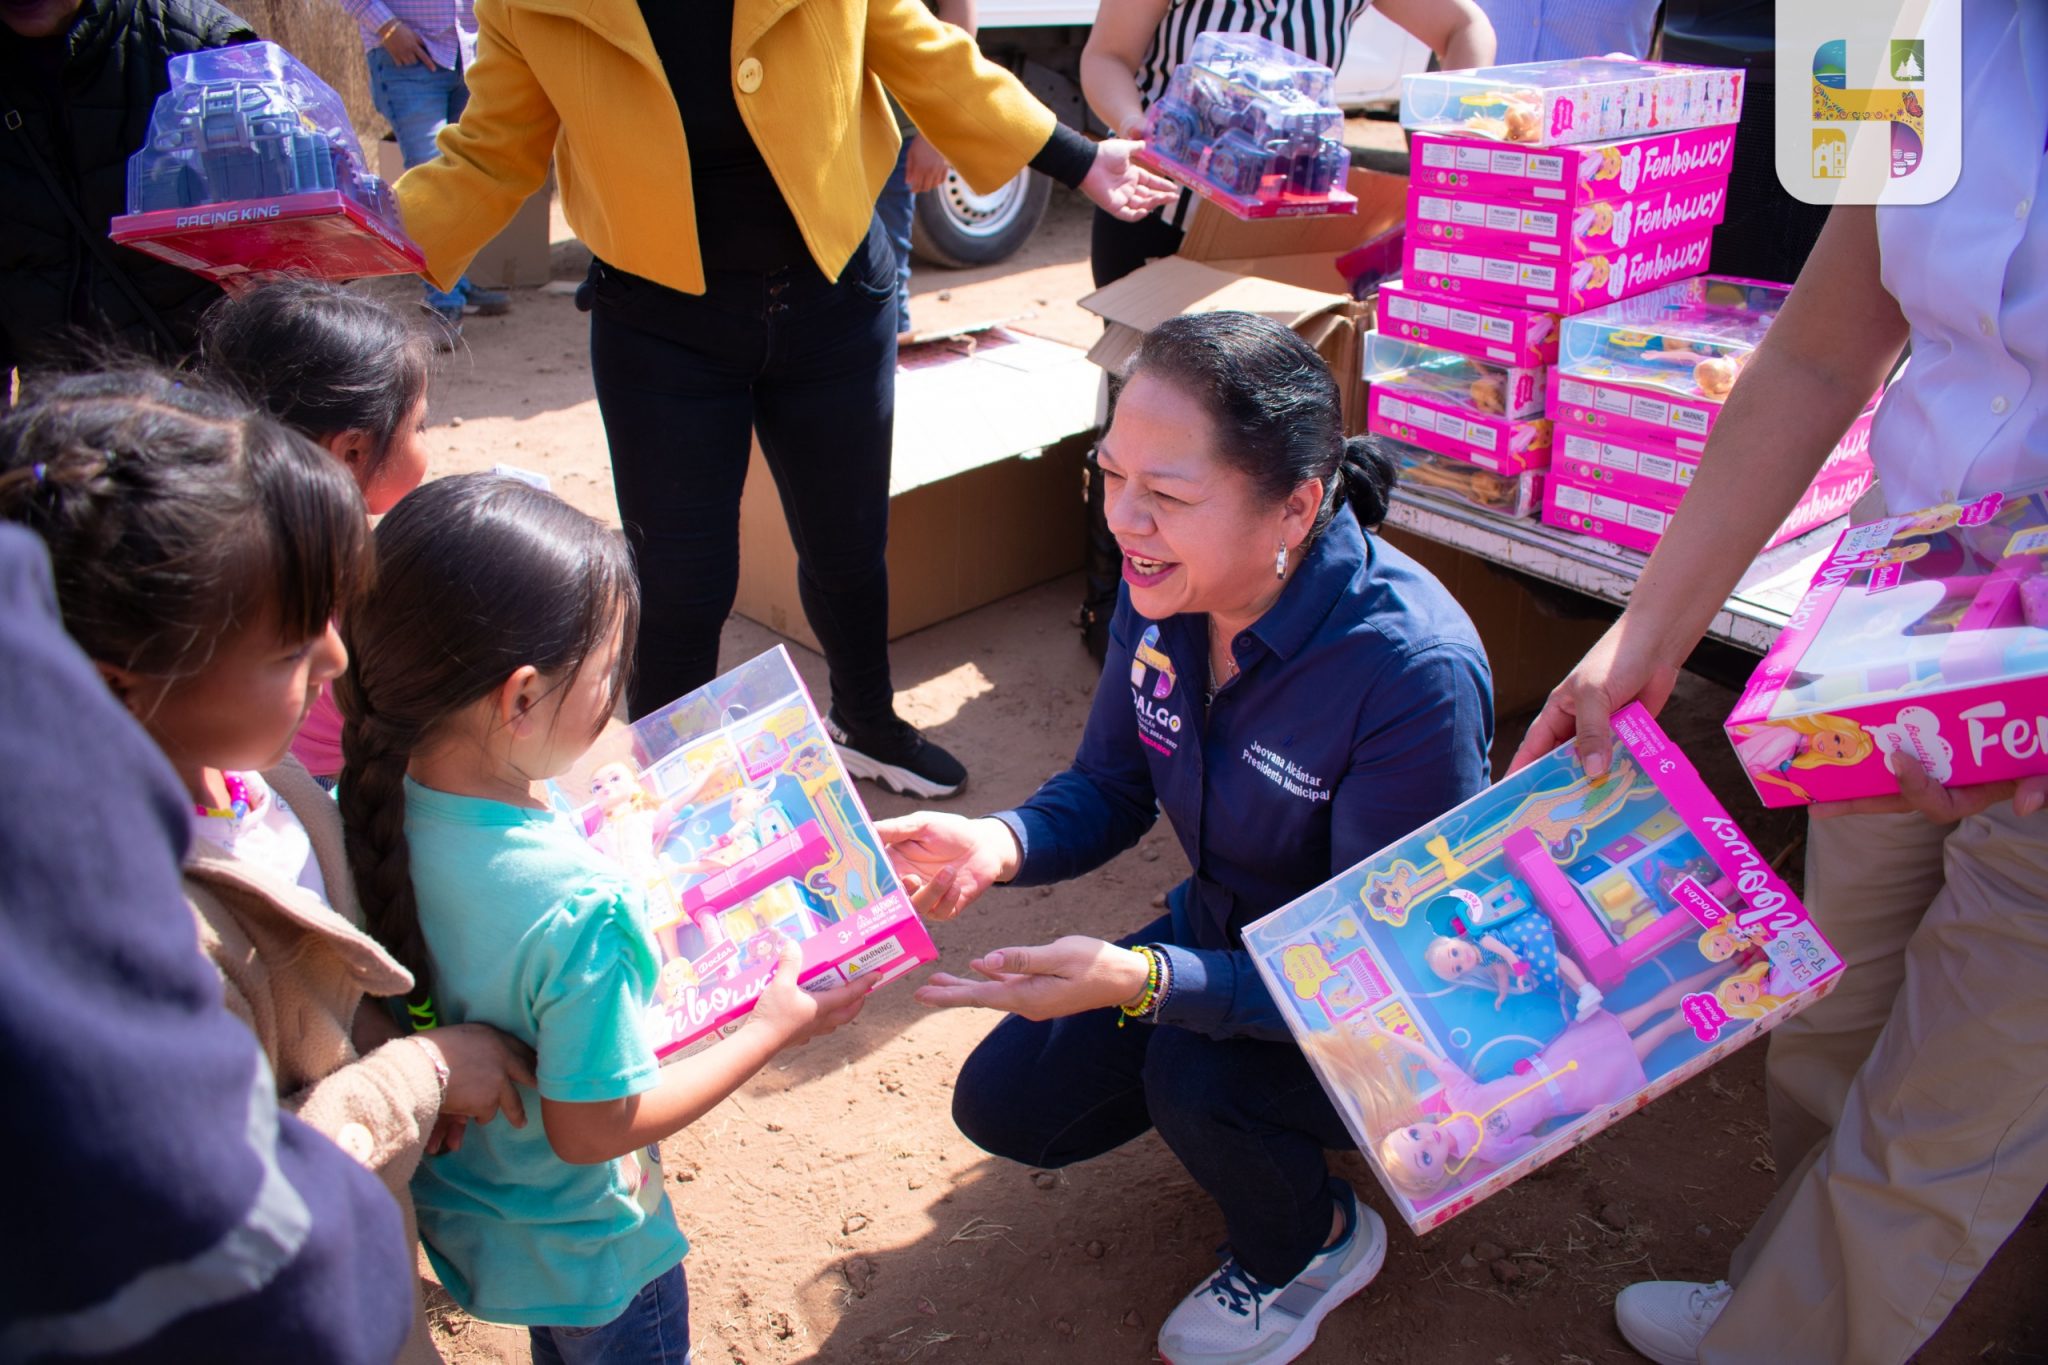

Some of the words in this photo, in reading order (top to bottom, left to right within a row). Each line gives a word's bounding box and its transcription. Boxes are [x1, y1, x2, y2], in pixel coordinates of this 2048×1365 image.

[176, 209, 239, 229] RACING
[241, 204, 281, 220] KING
[1242, 748, 1283, 786] Presidenta
[1283, 776, 1330, 802] Municipal
[1251, 740, 1286, 769] Jeovana
[1284, 760, 1322, 787] Alcántar
[698, 946, 734, 974] Doctor
[1792, 931, 1826, 972] TOYS
